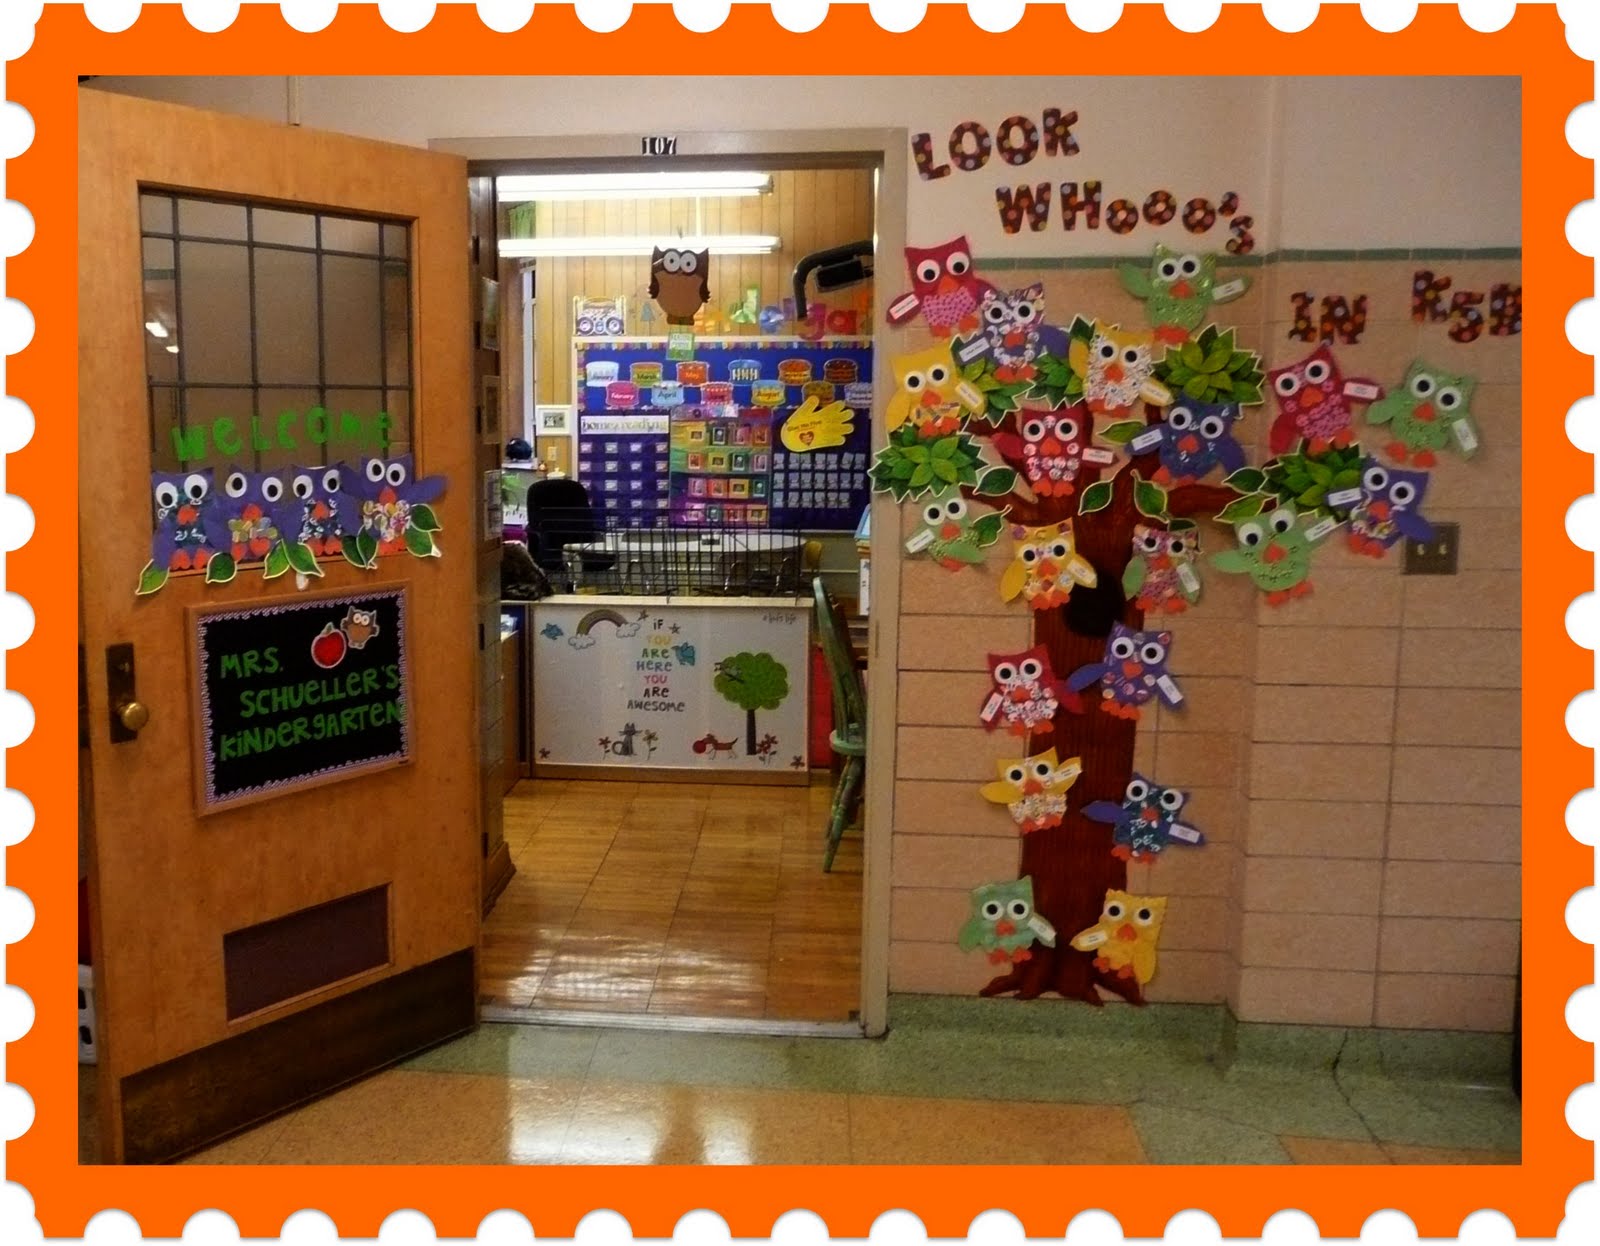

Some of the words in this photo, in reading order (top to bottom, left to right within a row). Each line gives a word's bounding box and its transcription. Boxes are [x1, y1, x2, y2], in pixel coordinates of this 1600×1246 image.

[642, 136, 677, 156] 107
[911, 108, 1080, 181] LOOK
[1289, 291, 1368, 345] IN
[647, 634, 672, 646] YOU
[220, 647, 284, 679] MRS.
[644, 675, 668, 685] YOU
